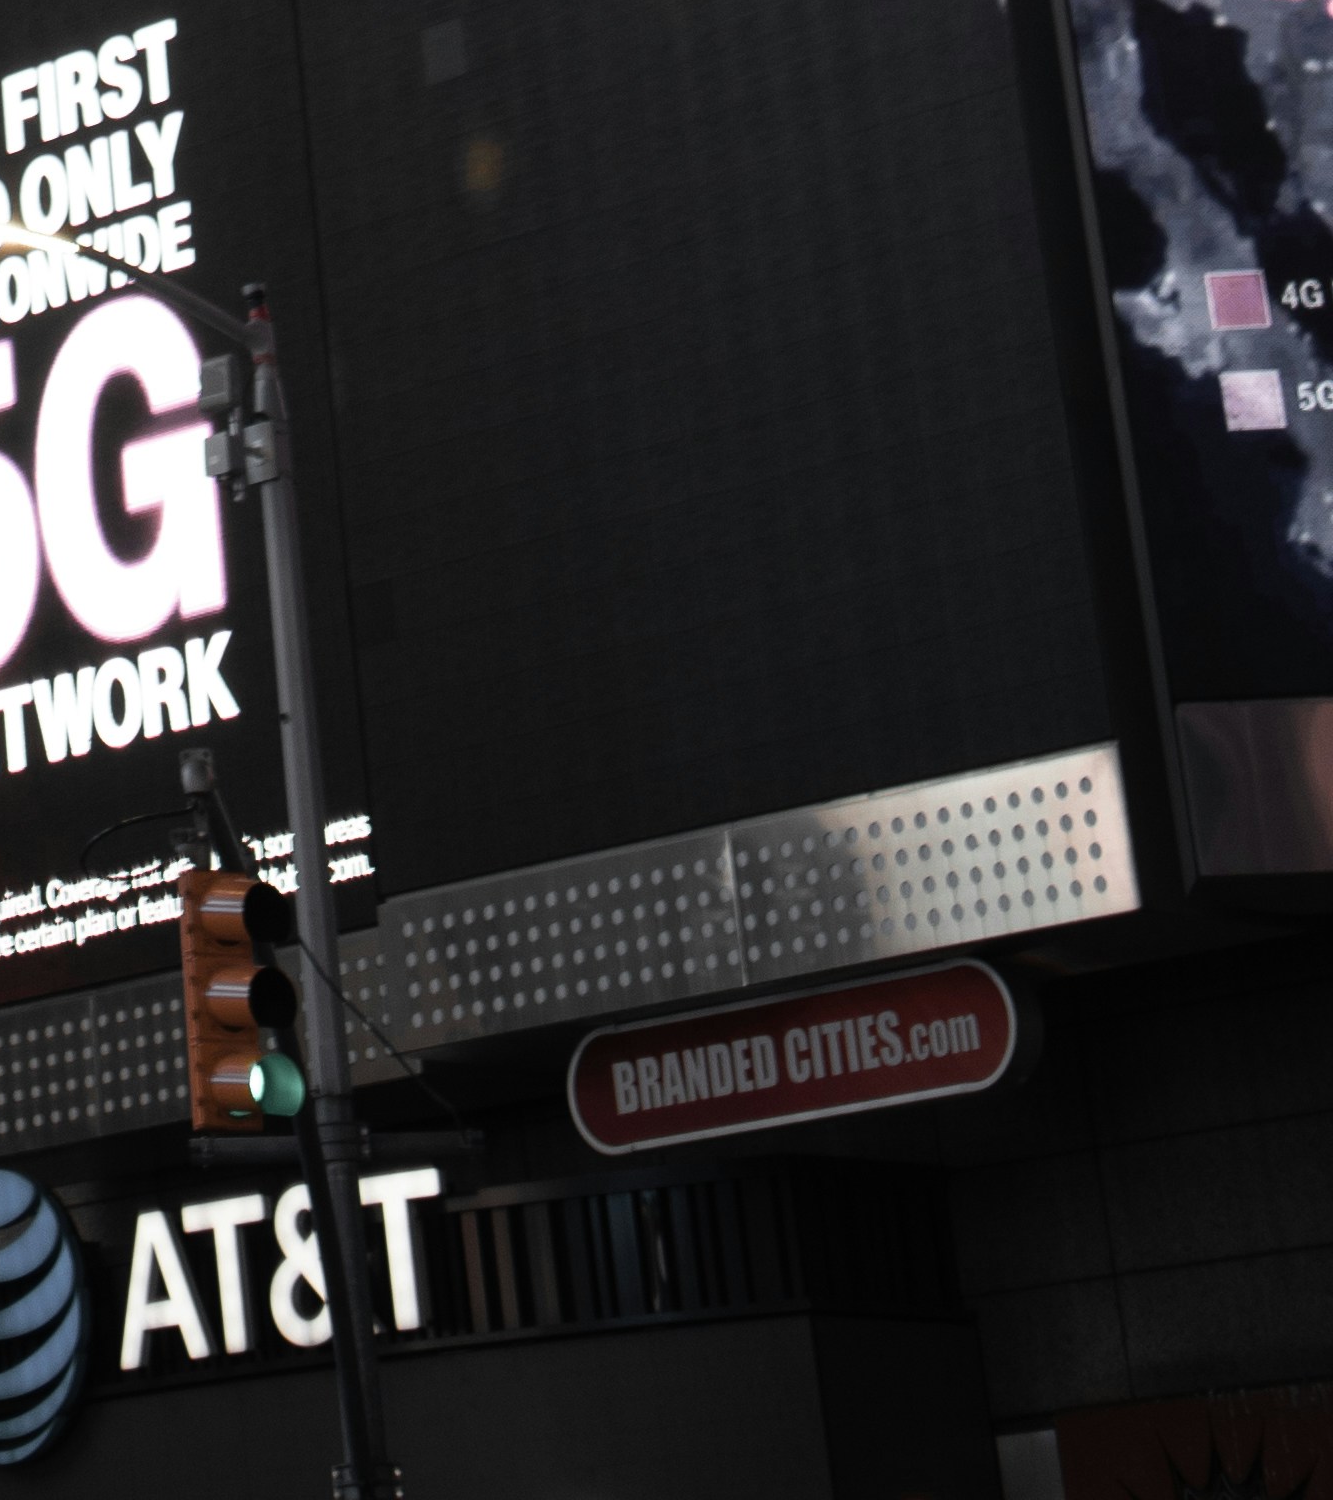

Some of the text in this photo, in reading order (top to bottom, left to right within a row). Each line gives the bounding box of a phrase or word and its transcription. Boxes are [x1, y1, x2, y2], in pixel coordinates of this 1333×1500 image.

[1, 18, 178, 155] FIRST
[19, 110, 184, 236] ONLY
[1282, 278, 1325, 310] 4G
[1297, 378, 1333, 412] 5G
[74, 905, 116, 946] plan
[136, 894, 184, 926] featu
[611, 1008, 983, 1116] BRANDED CITIES.com
[120, 1167, 440, 1372] AT&T
